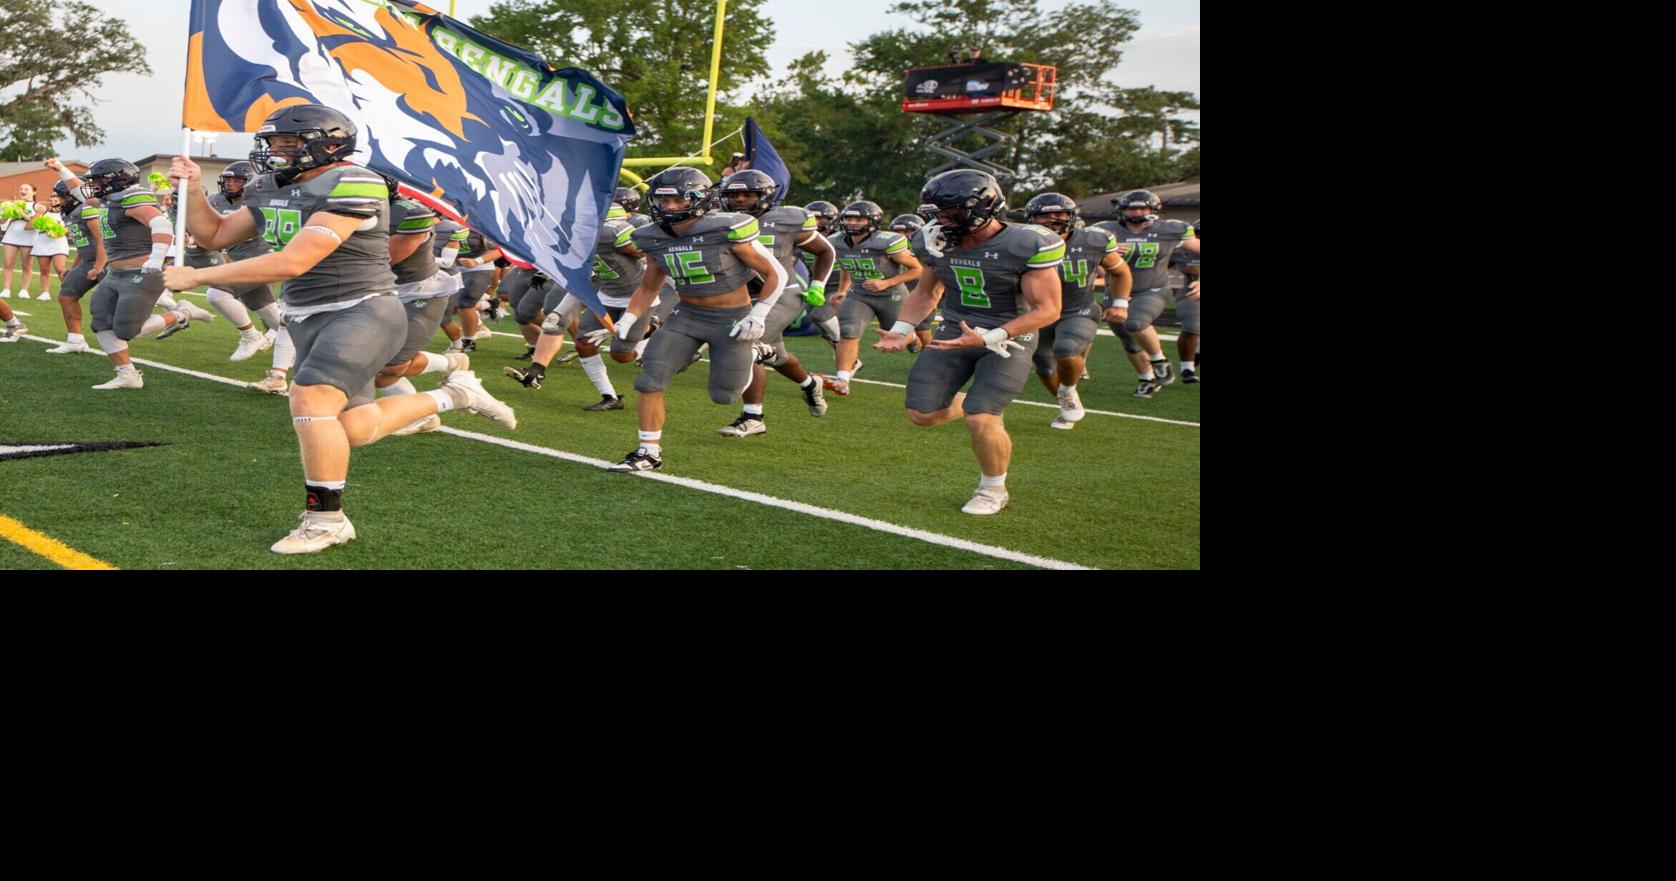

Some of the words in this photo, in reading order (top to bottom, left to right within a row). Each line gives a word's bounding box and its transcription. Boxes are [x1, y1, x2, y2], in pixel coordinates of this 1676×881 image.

[433, 26, 625, 130] BENGALS
[663, 250, 716, 285] 15
[950, 258, 981, 267] BENGALS
[950, 265, 992, 309] 8
